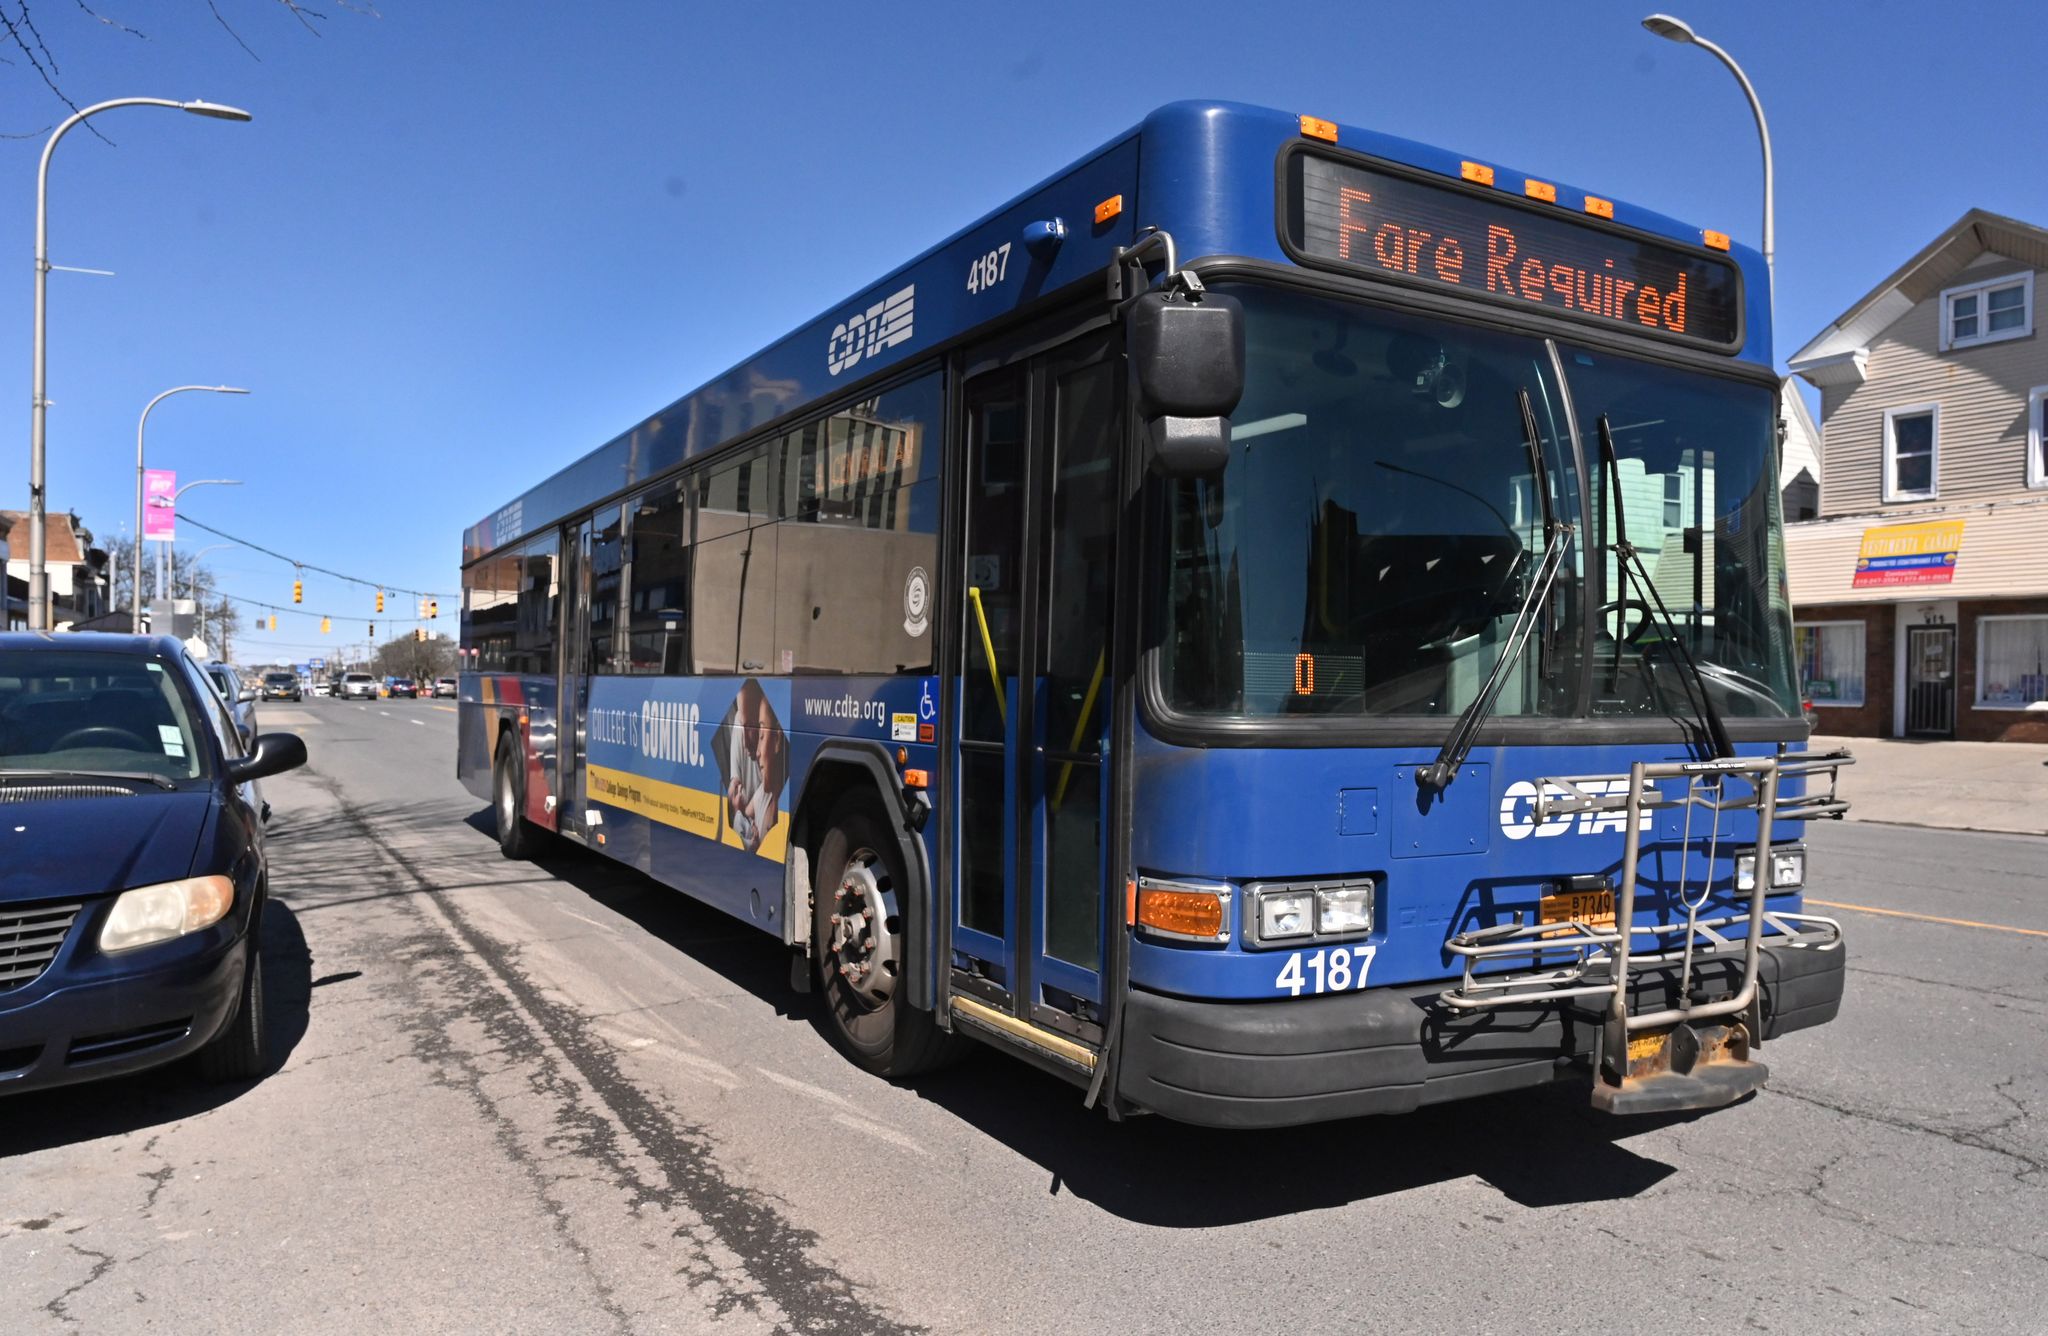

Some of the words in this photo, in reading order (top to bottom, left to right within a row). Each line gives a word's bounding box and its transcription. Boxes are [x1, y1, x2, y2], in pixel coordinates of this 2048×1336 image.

[967, 242, 1011, 294] 4187
[1339, 188, 1463, 283] Fare
[1489, 225, 1686, 333] Required
[828, 283, 915, 376] CDTA
[592, 708, 626, 745] COLLEGE
[629, 711, 638, 748] IS
[642, 700, 704, 768] COMING.
[805, 694, 885, 727] www.cdta.org
[1500, 779, 1654, 840] CDTA
[1275, 946, 1376, 997] 4187
